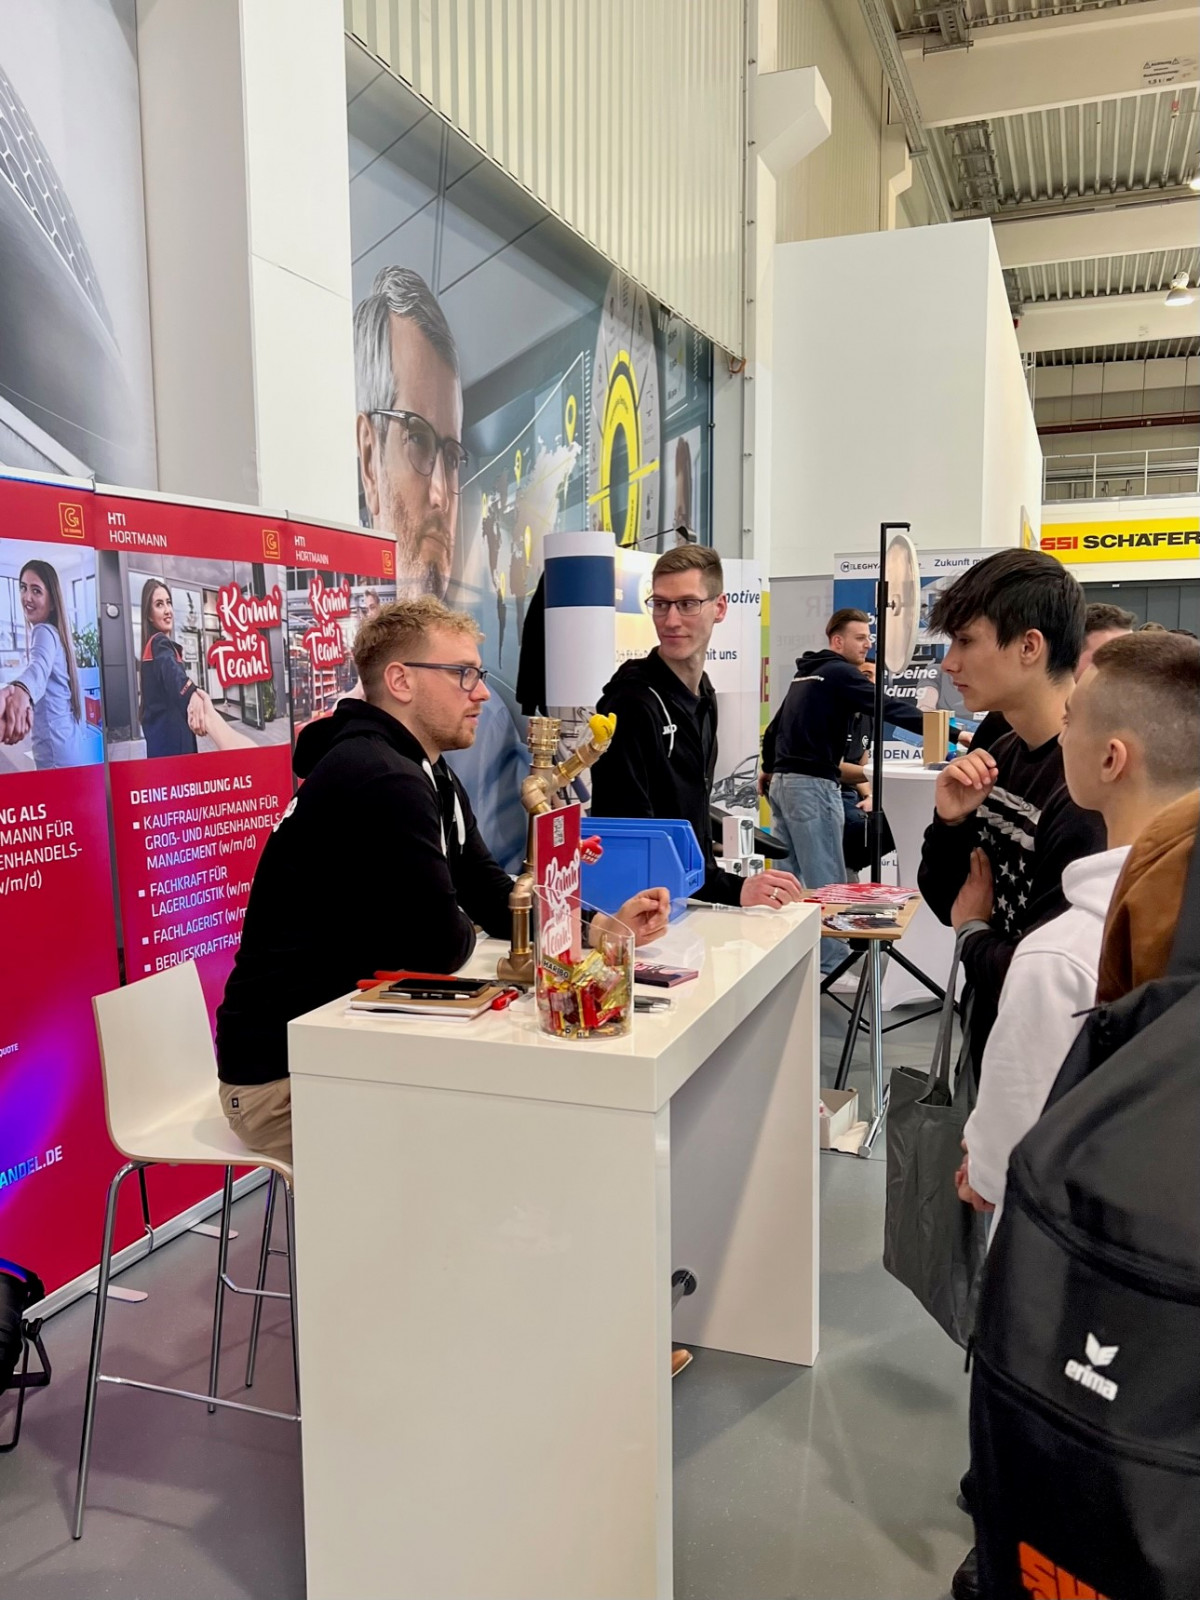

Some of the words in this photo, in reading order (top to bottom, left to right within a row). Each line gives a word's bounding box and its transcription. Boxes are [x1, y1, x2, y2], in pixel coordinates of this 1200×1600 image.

[107, 511, 126, 526] HTI
[109, 530, 168, 548] HORTMANN
[294, 535, 306, 547] HTI
[1040, 536, 1078, 550] SSI
[1083, 531, 1200, 549] SCHÄFER
[296, 550, 329, 565] HORTMANN
[934, 558, 970, 567] Zukunft
[321, 620, 335, 638] ins
[235, 631, 258, 652] ins
[305, 628, 343, 665] Team!
[210, 640, 269, 682] Team!
[719, 650, 738, 660] uns
[130, 786, 168, 805] DEINE
[170, 778, 231, 800] AUSBILDUNG
[232, 775, 253, 790] ALS
[20, 803, 47, 822] ALS
[143, 798, 257, 830] KAUFFRAU/KAUFMANN
[259, 795, 279, 810] FÜR
[0, 825, 43, 847] MANN
[46, 819, 74, 840] FÜR
[182, 826, 201, 843] UND
[147, 842, 217, 871] MANAGEMENT
[219, 834, 257, 857] (w/m/d)
[150, 870, 208, 897] FACHKRAFT
[208, 865, 228, 882] FÜR
[151, 885, 225, 917] LAGERLOGISTIK
[153, 911, 224, 944] FACHLAGERIST
[155, 930, 243, 971] BERUFSKRAFTFAH
[543, 959, 569, 979] HARIBO
[0, 1145, 63, 1190] ANDEL.DE
[1065, 1359, 1118, 1401] erima
